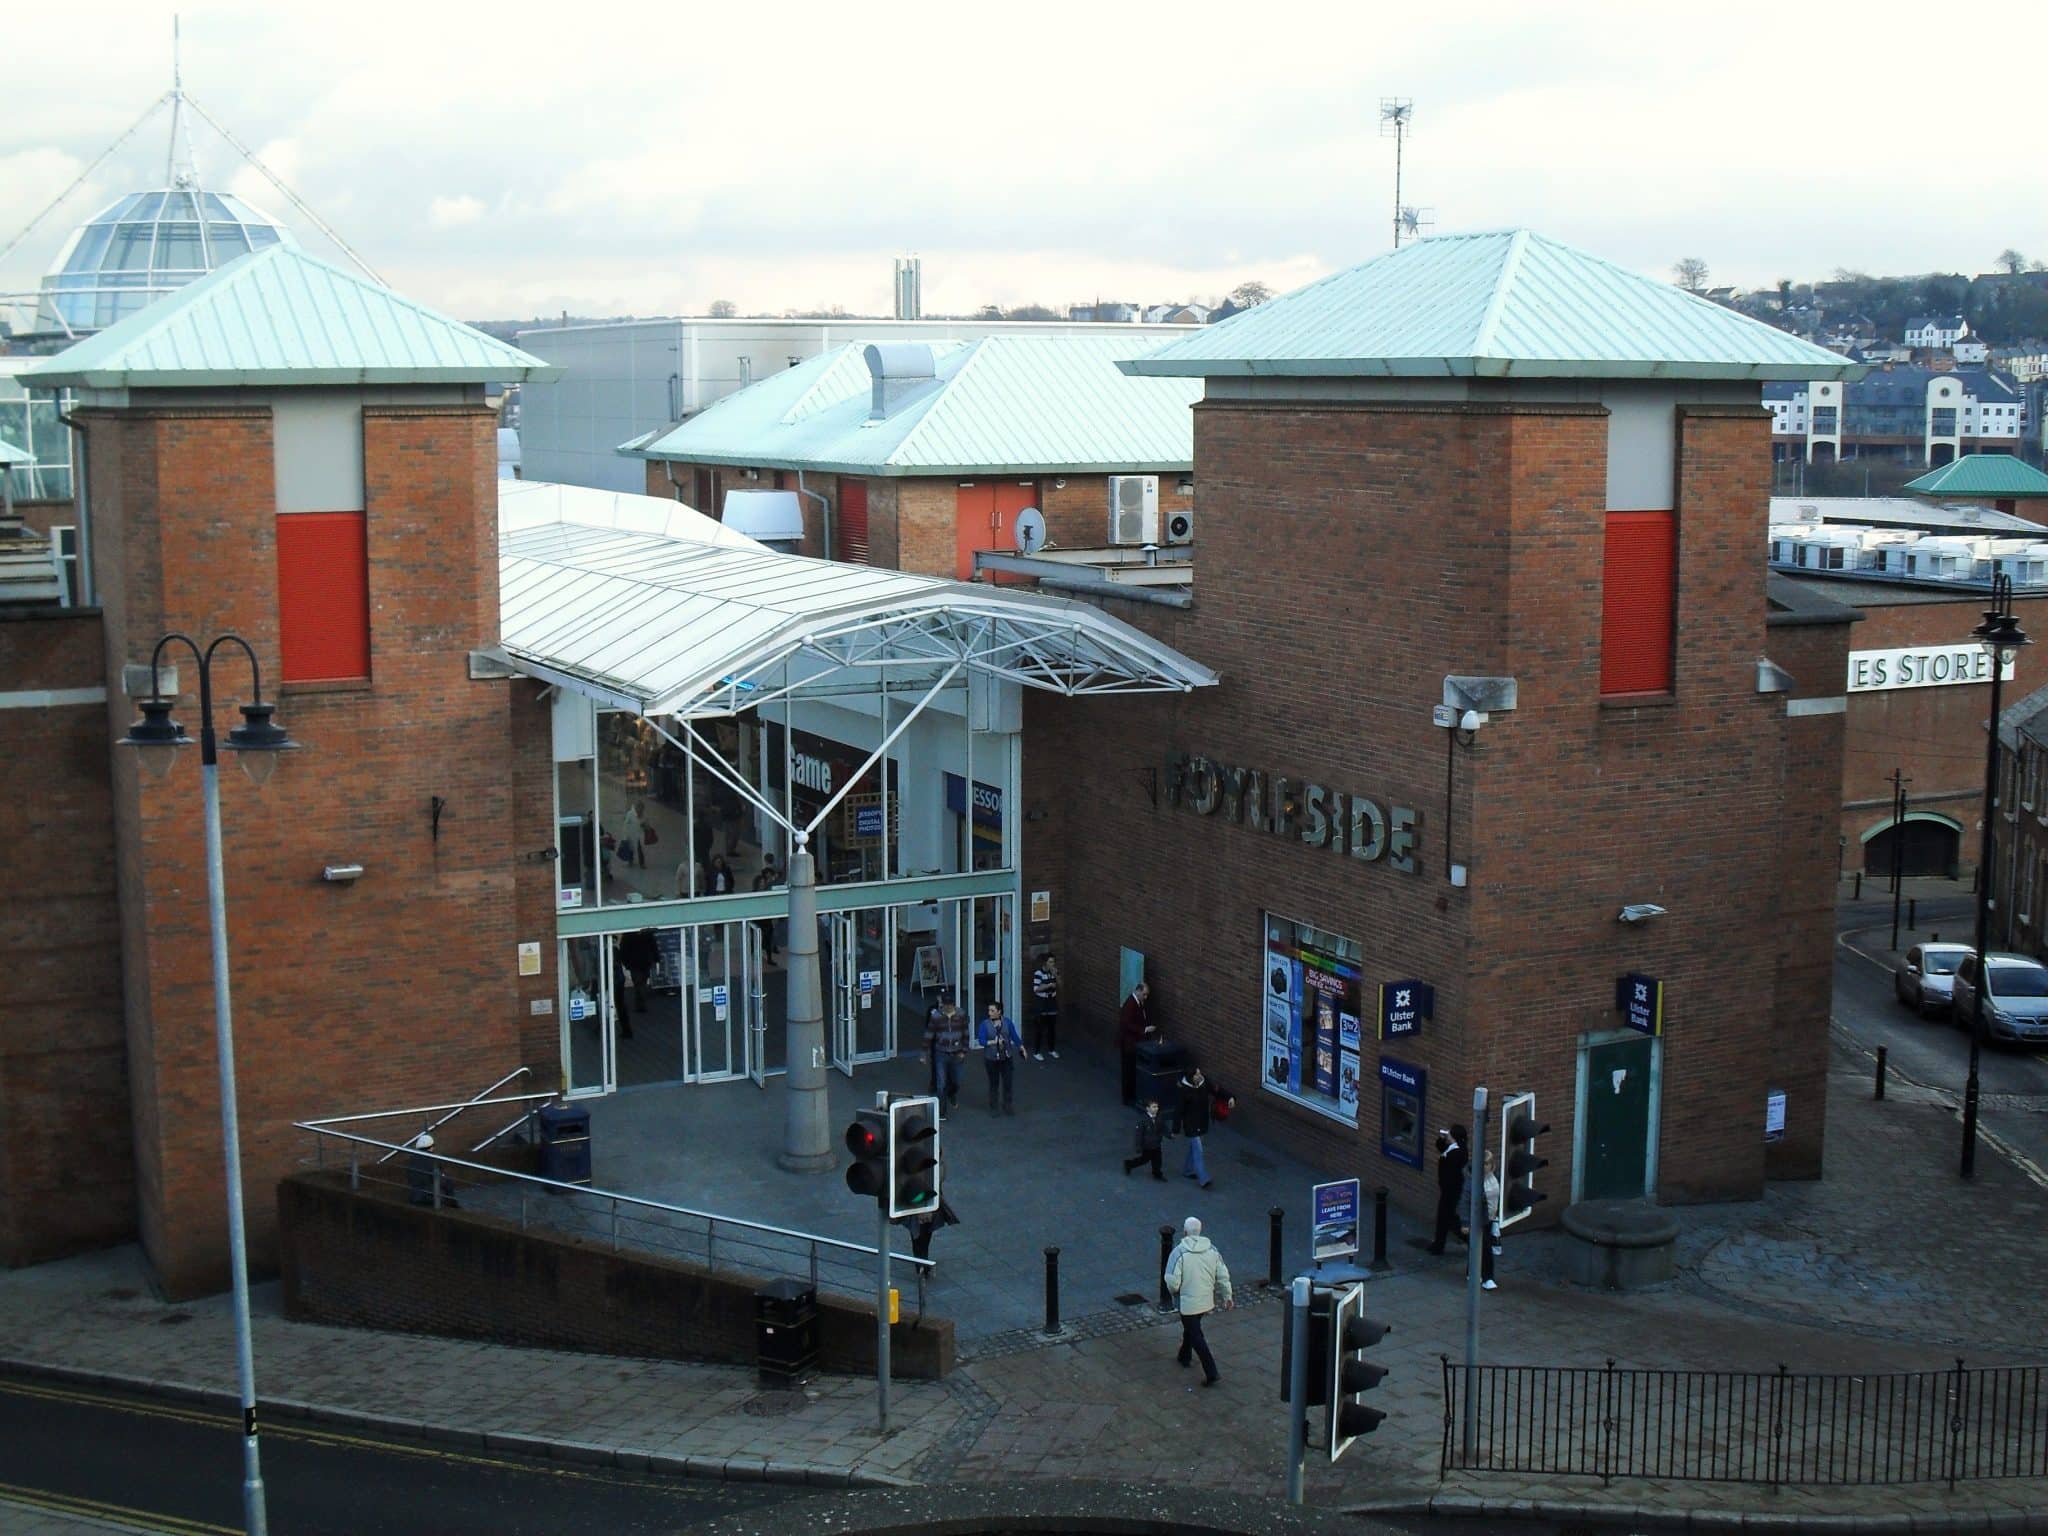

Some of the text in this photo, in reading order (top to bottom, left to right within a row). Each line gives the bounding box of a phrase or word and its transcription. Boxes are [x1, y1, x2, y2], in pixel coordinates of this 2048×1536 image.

[1389, 1010, 1415, 1021] Ulster
[1342, 1020, 1347, 1030] 3
[1352, 1023, 1358, 1032] 2
[1391, 1020, 1413, 1032] Bank
[1387, 1068, 1415, 1085] Ulster Bank
